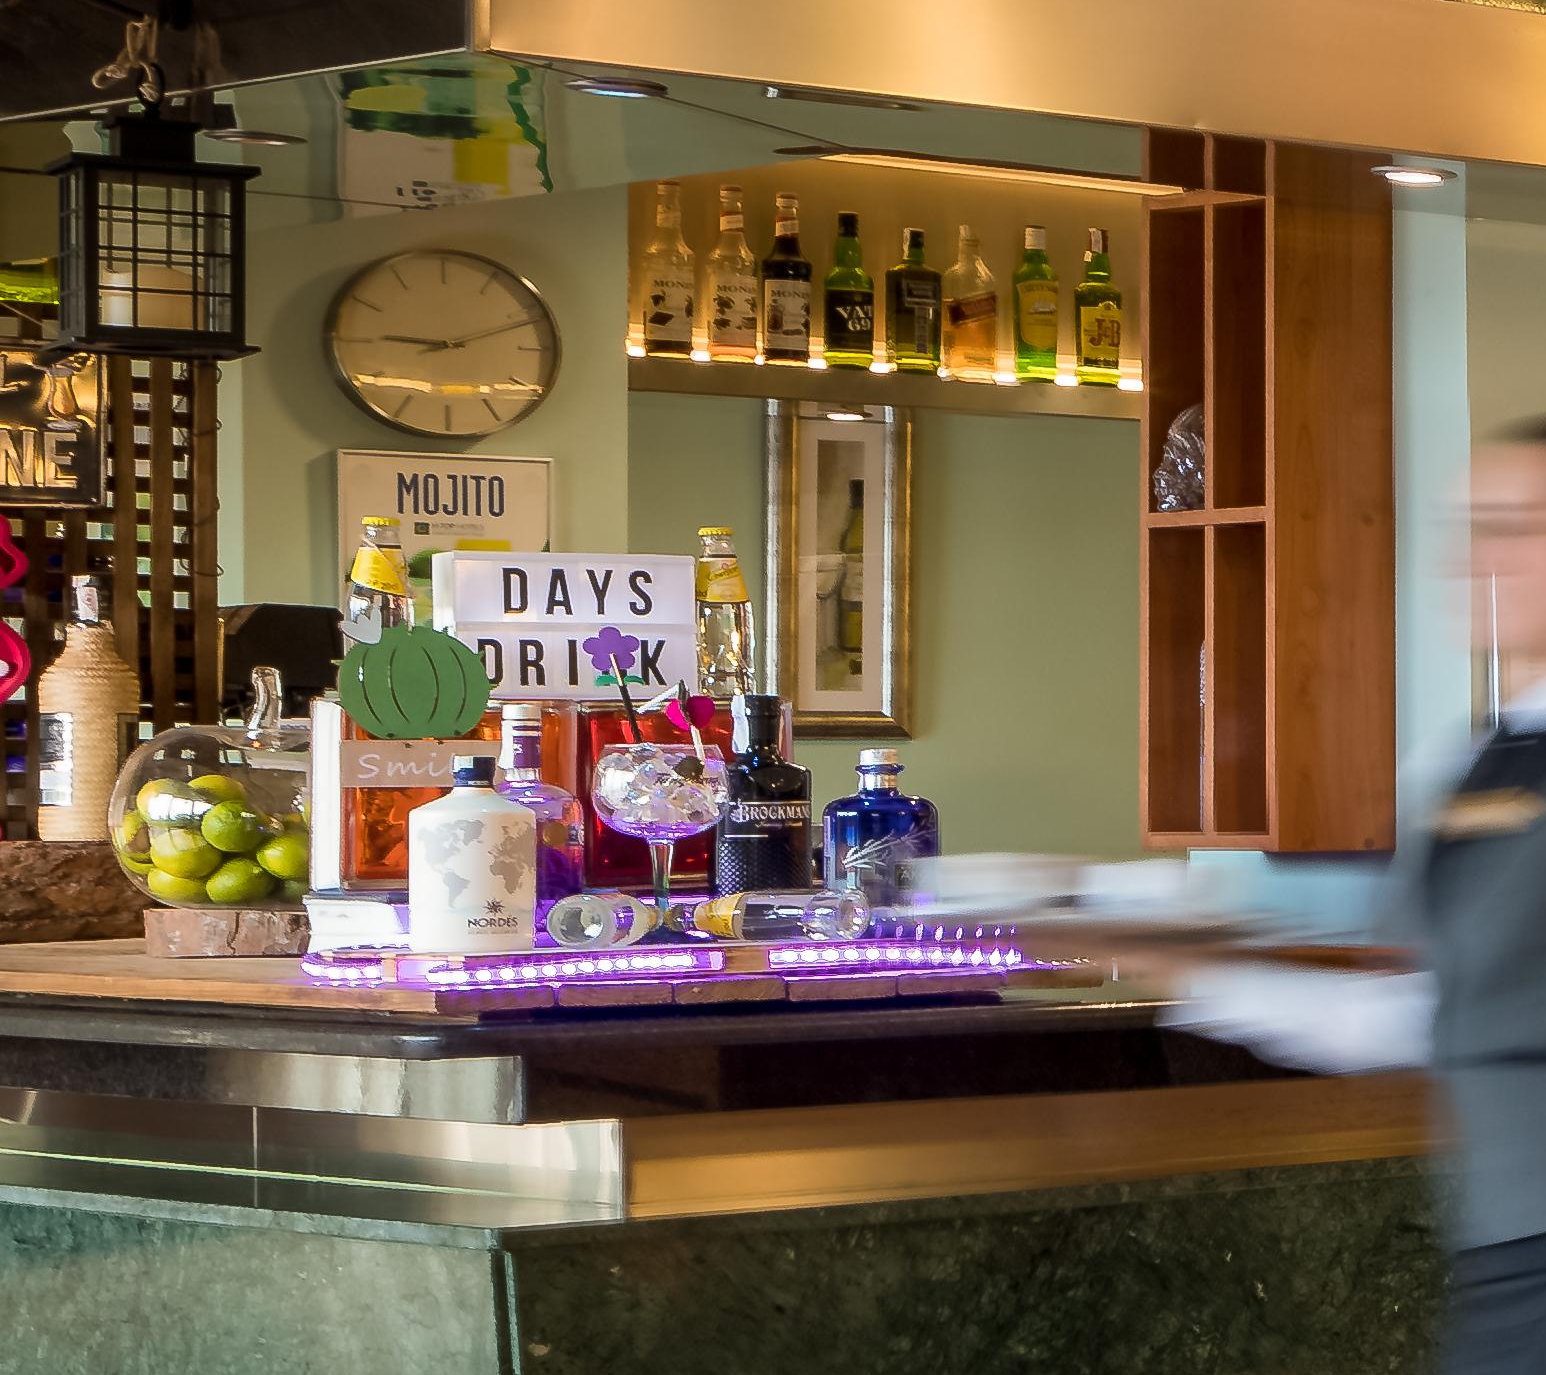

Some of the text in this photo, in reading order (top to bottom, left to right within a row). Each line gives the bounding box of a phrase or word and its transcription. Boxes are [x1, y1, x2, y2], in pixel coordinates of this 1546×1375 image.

[396, 472, 505, 517] MOJITO
[502, 567, 653, 616] DAYS
[477, 638, 667, 687] DRIK
